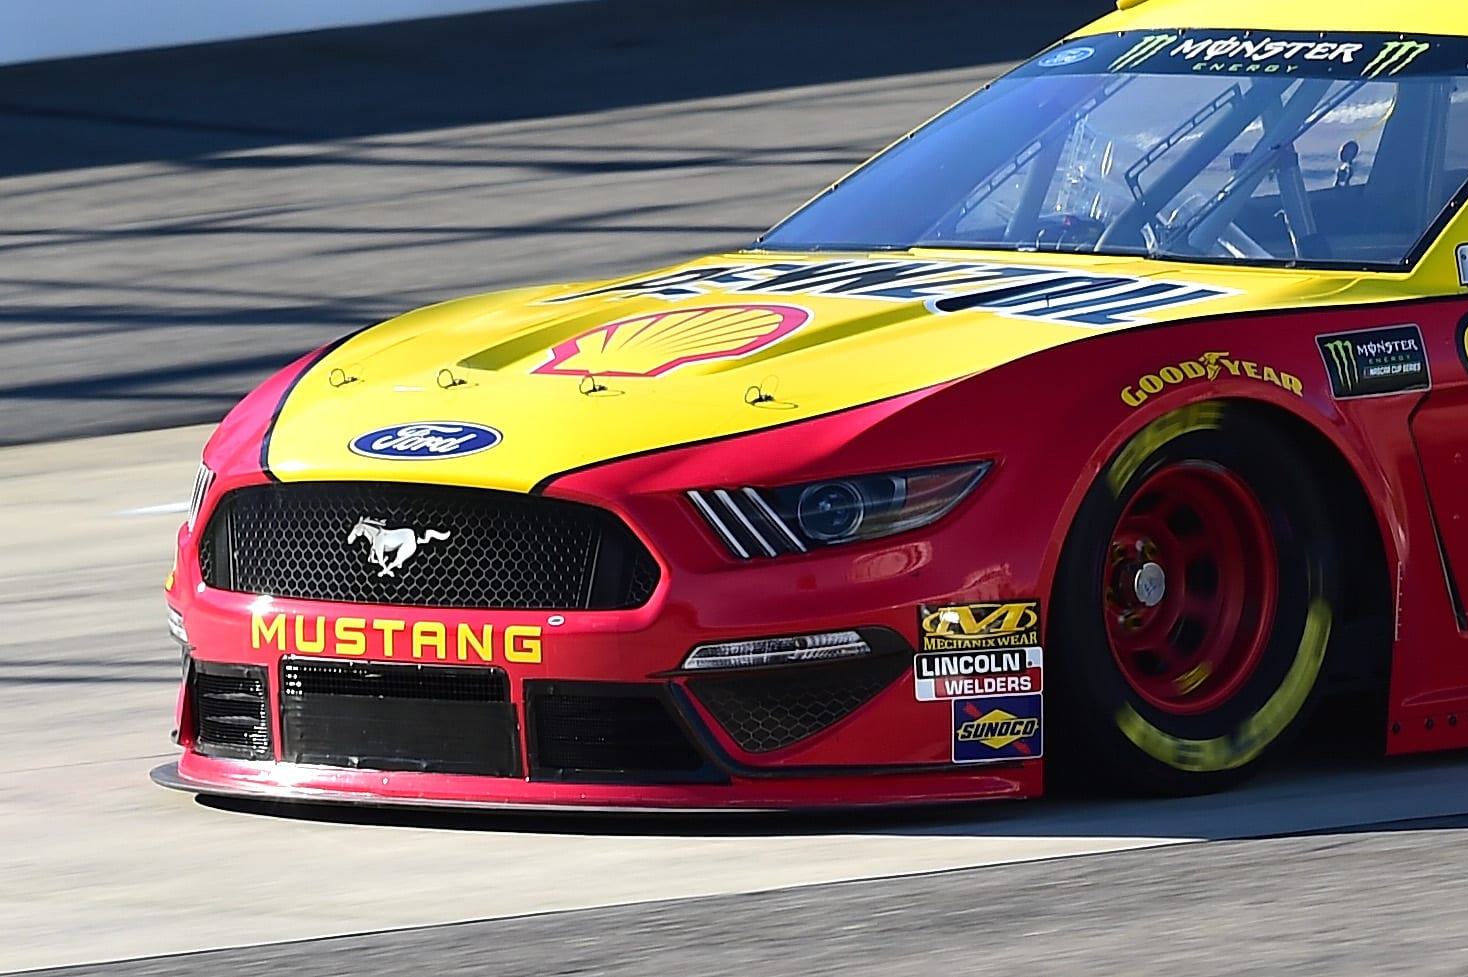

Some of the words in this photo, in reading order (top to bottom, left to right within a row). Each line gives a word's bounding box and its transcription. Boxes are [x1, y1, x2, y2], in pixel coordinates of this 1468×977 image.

[1192, 61, 1299, 74] ENERGY
[1356, 338, 1419, 357] MONSTER
[1368, 354, 1411, 365] ENERGY
[1391, 364, 1403, 375] CUP
[1120, 352, 1304, 407] GOODYEAR
[370, 423, 477, 456] Ford
[250, 614, 544, 664] MUSTANG
[923, 635, 996, 652] MECHANIX
[997, 631, 1038, 647] WEAR
[921, 652, 1021, 677] LINCOLN
[944, 676, 1032, 696] WELDERS
[958, 719, 1038, 741] SUNOCO
